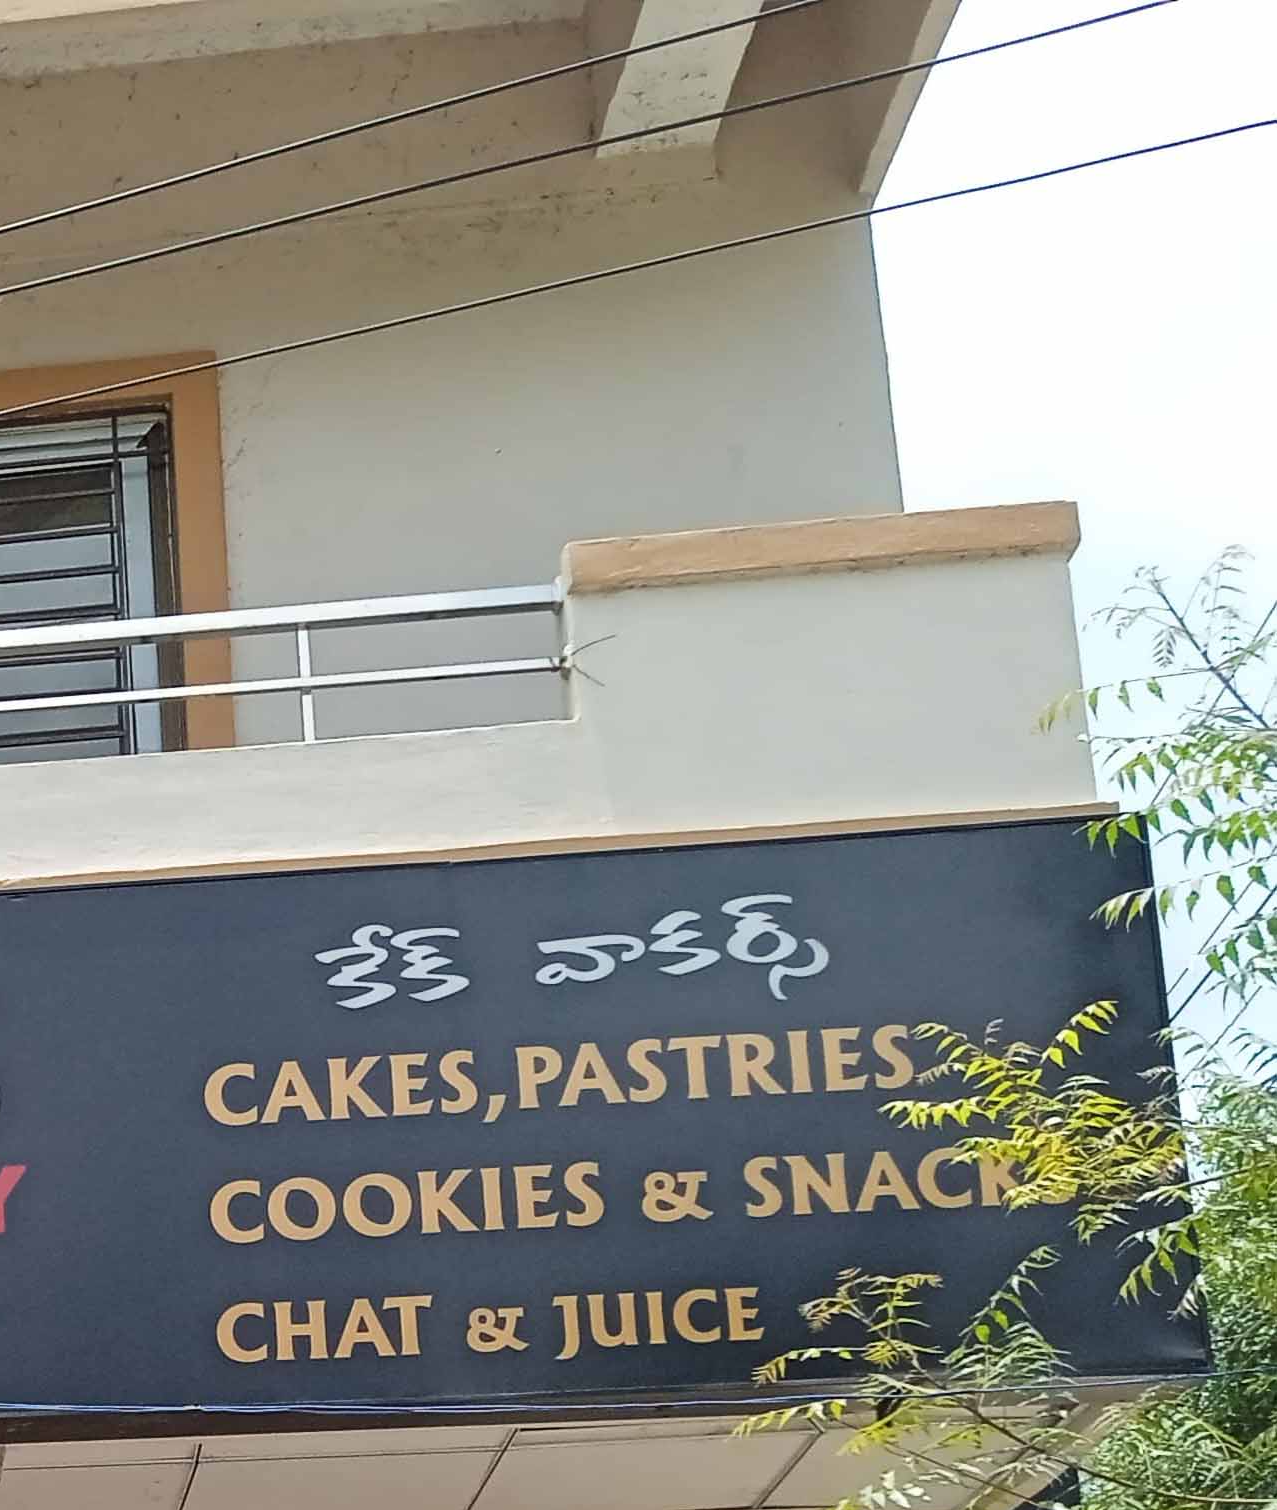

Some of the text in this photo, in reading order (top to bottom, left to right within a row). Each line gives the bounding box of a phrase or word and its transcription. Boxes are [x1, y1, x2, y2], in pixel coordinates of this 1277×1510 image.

[203, 1023, 914, 1127] CAKES,PASTRIES
[210, 1138, 1078, 1243] COOKIES & SNACK
[216, 1286, 766, 1362] CHAT & JUICE
